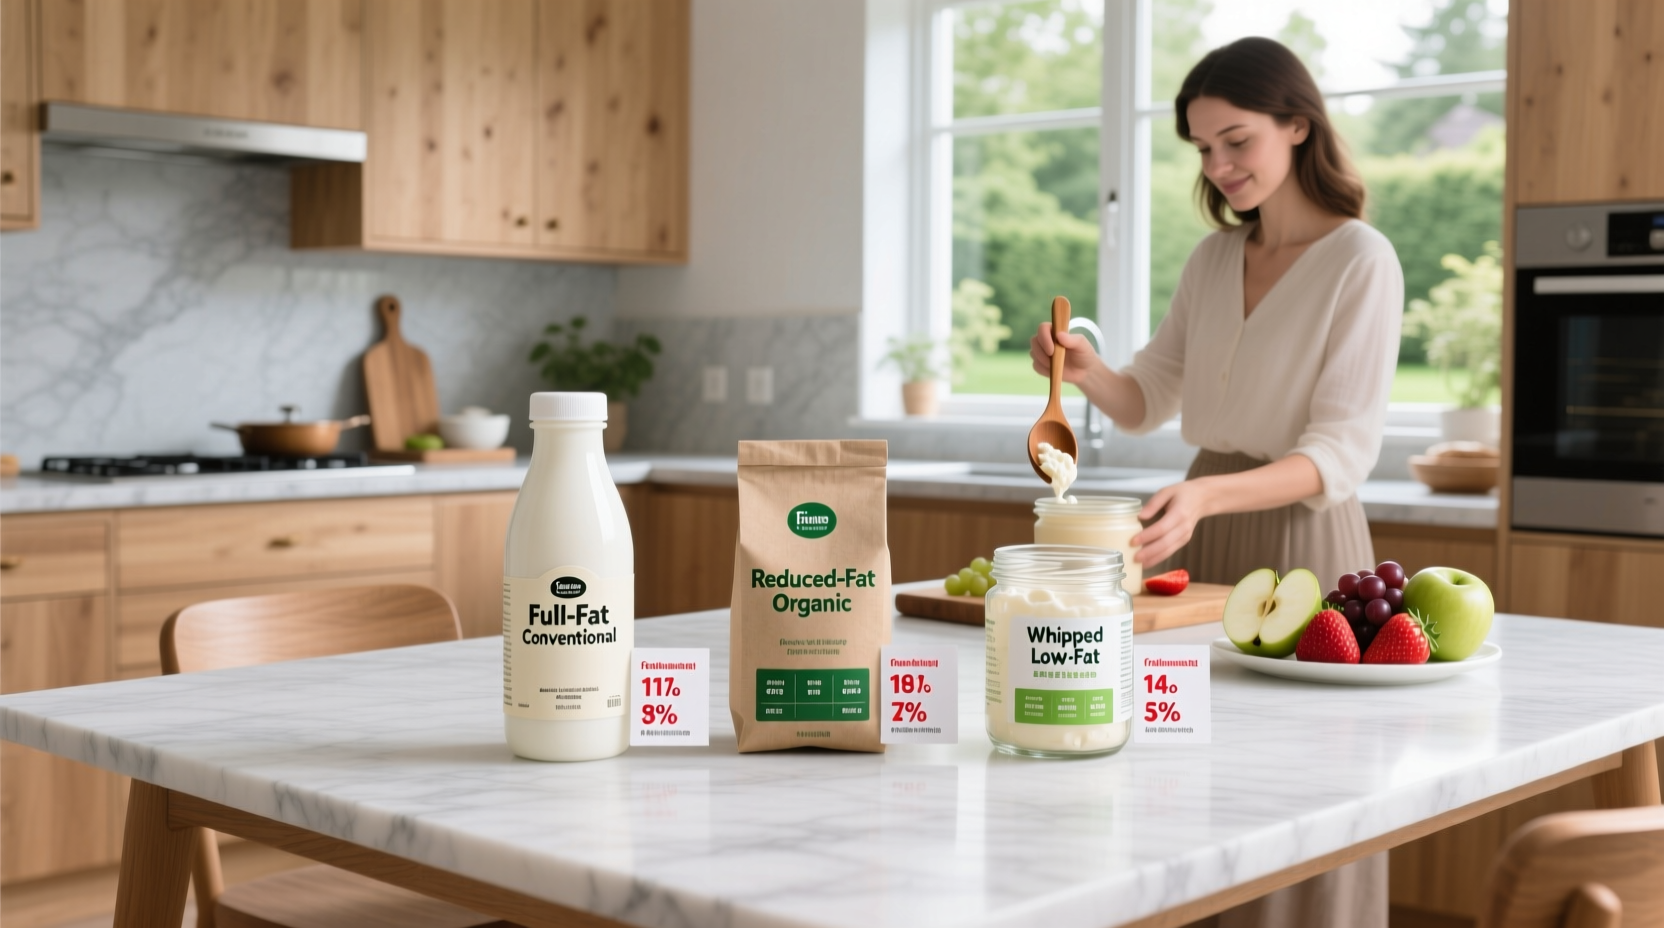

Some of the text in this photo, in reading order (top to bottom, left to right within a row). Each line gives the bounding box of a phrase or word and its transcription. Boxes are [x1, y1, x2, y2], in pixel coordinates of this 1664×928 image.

[751, 568, 876, 588] Reduced-Fat
[529, 604, 609, 625] Full-Fat
[772, 593, 852, 617] Organic
[522, 627, 616, 645] Conventional
[1027, 626, 1103, 648] Whipped
[1031, 647, 1100, 665] Low-Fat
[1144, 701, 1181, 722] 5%
